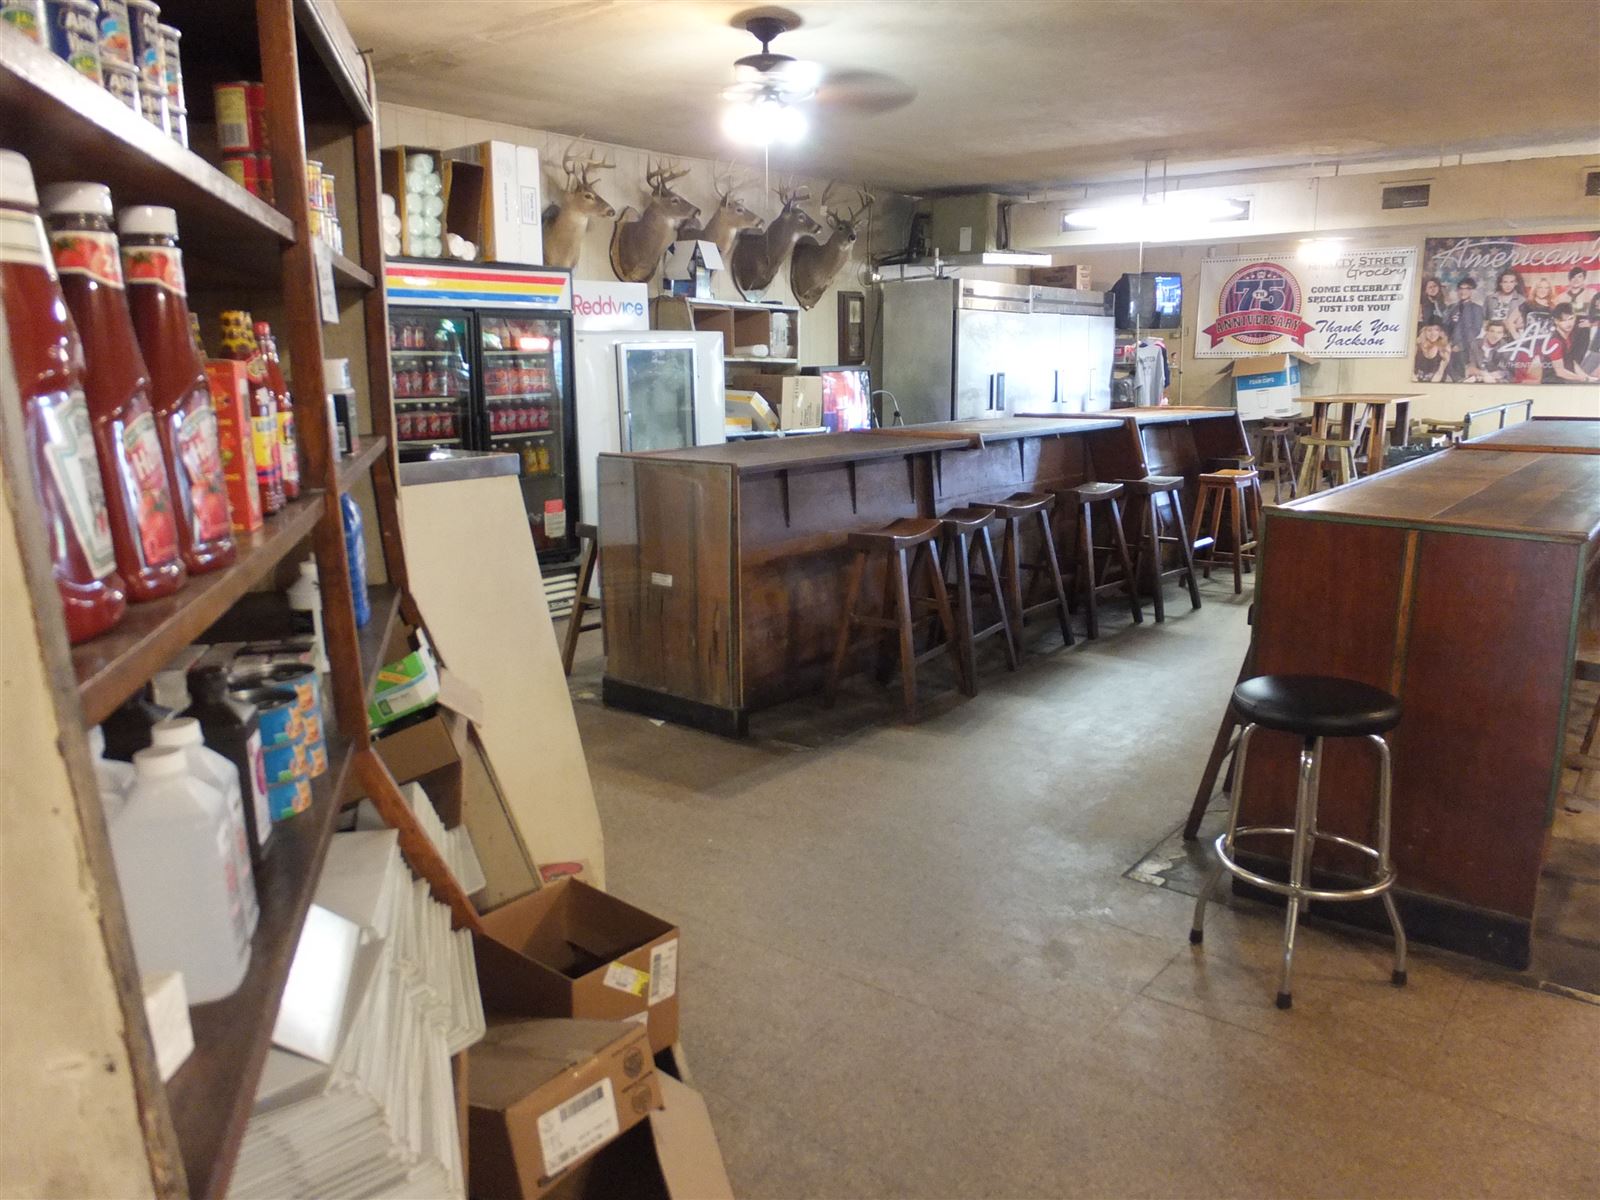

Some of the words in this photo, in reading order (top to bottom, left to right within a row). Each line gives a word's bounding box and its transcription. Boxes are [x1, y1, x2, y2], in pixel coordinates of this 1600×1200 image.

[1359, 255, 1408, 267] STREET
[1432, 238, 1583, 269] American
[1346, 264, 1408, 281] Grocery
[1233, 277, 1287, 313] 75
[1310, 285, 1341, 294] COME
[1342, 283, 1402, 293] CELEBRATE
[1307, 294, 1355, 304] SPECIALS
[1356, 293, 1405, 303] CREATED
[1318, 304, 1342, 313] JUST
[1344, 304, 1364, 313] FOR
[1367, 303, 1391, 312] YOU!
[1215, 314, 1301, 334] ANNIVERSARY
[1315, 319, 1363, 334] Thank
[1370, 318, 1400, 336] You
[1324, 332, 1385, 350] Jackson
